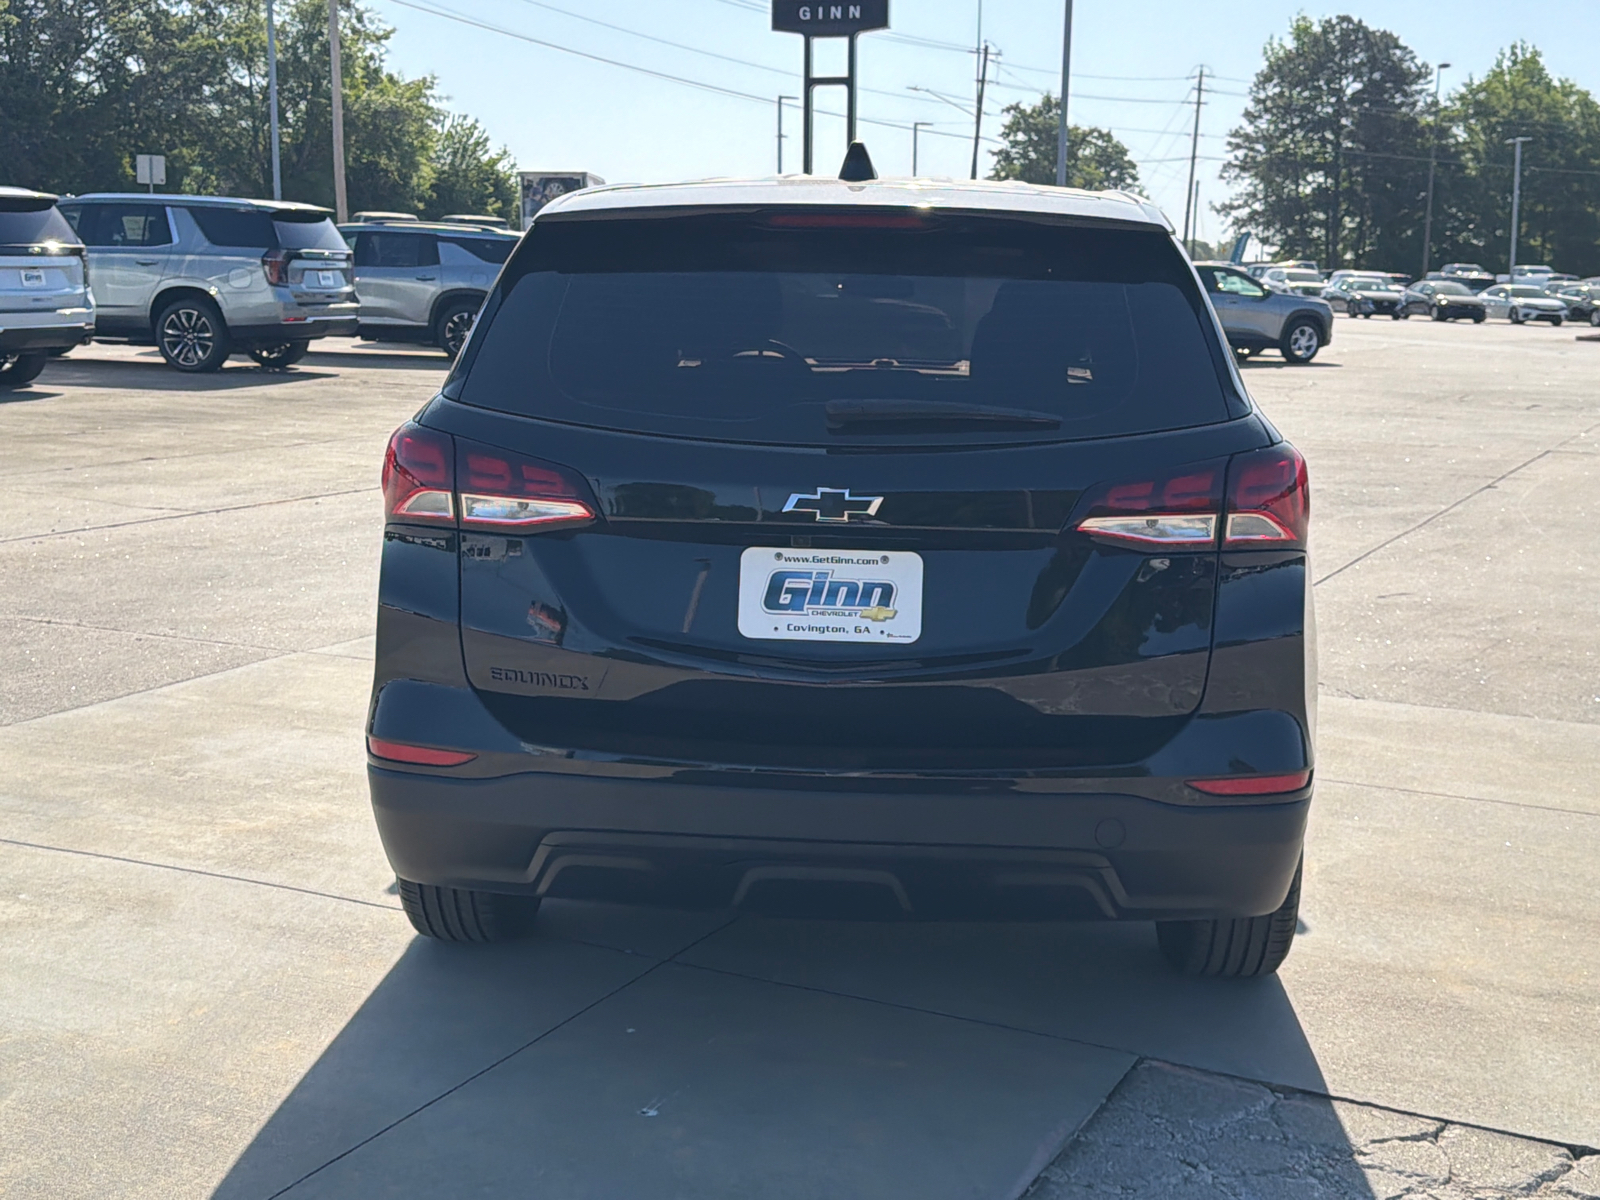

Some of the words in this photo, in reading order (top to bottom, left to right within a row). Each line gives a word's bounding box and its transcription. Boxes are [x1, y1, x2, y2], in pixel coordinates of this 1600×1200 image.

[798, 5, 861, 20] GINN
[784, 555, 879, 565] www.GetGinn.com
[762, 569, 897, 612] Ginn
[786, 623, 849, 635] Covington,
[854, 625, 871, 634] GA
[490, 667, 589, 690] EQUINOX
